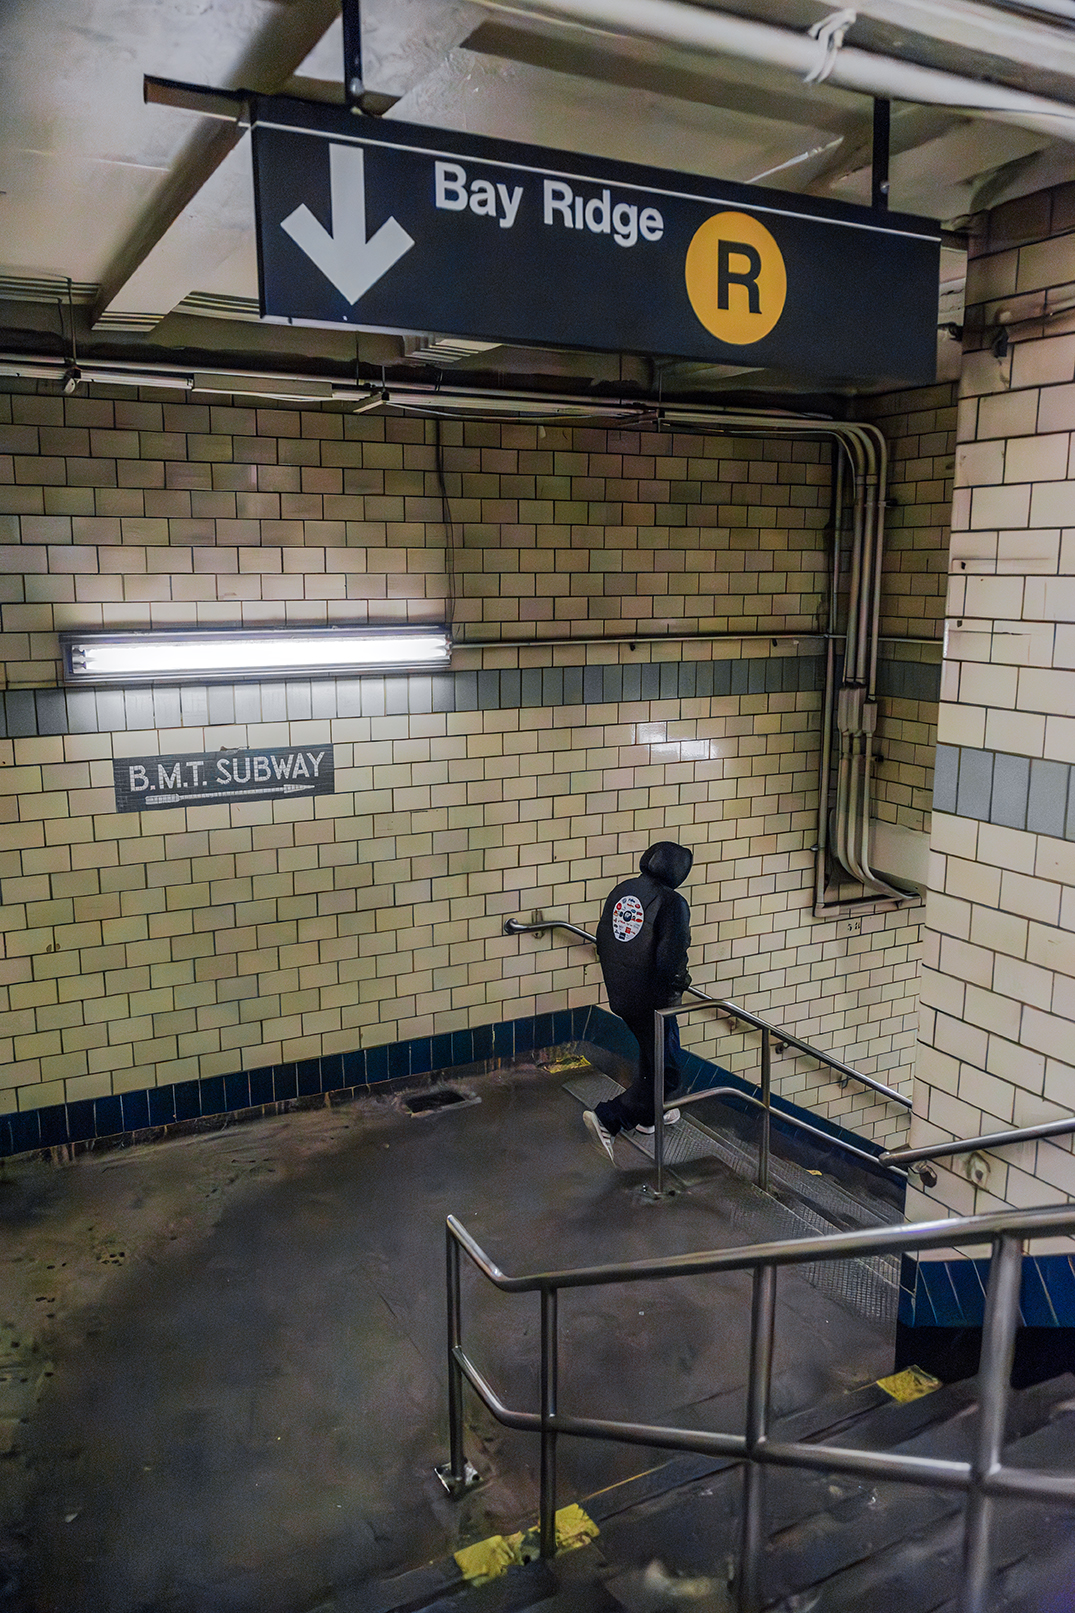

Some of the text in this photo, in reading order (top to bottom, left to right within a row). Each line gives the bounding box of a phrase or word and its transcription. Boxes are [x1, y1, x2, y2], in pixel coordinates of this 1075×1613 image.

[434, 161, 664, 247] Bay Ridge
[717, 239, 762, 314] R
[128, 751, 325, 792] B.M.T. SUBWAY
